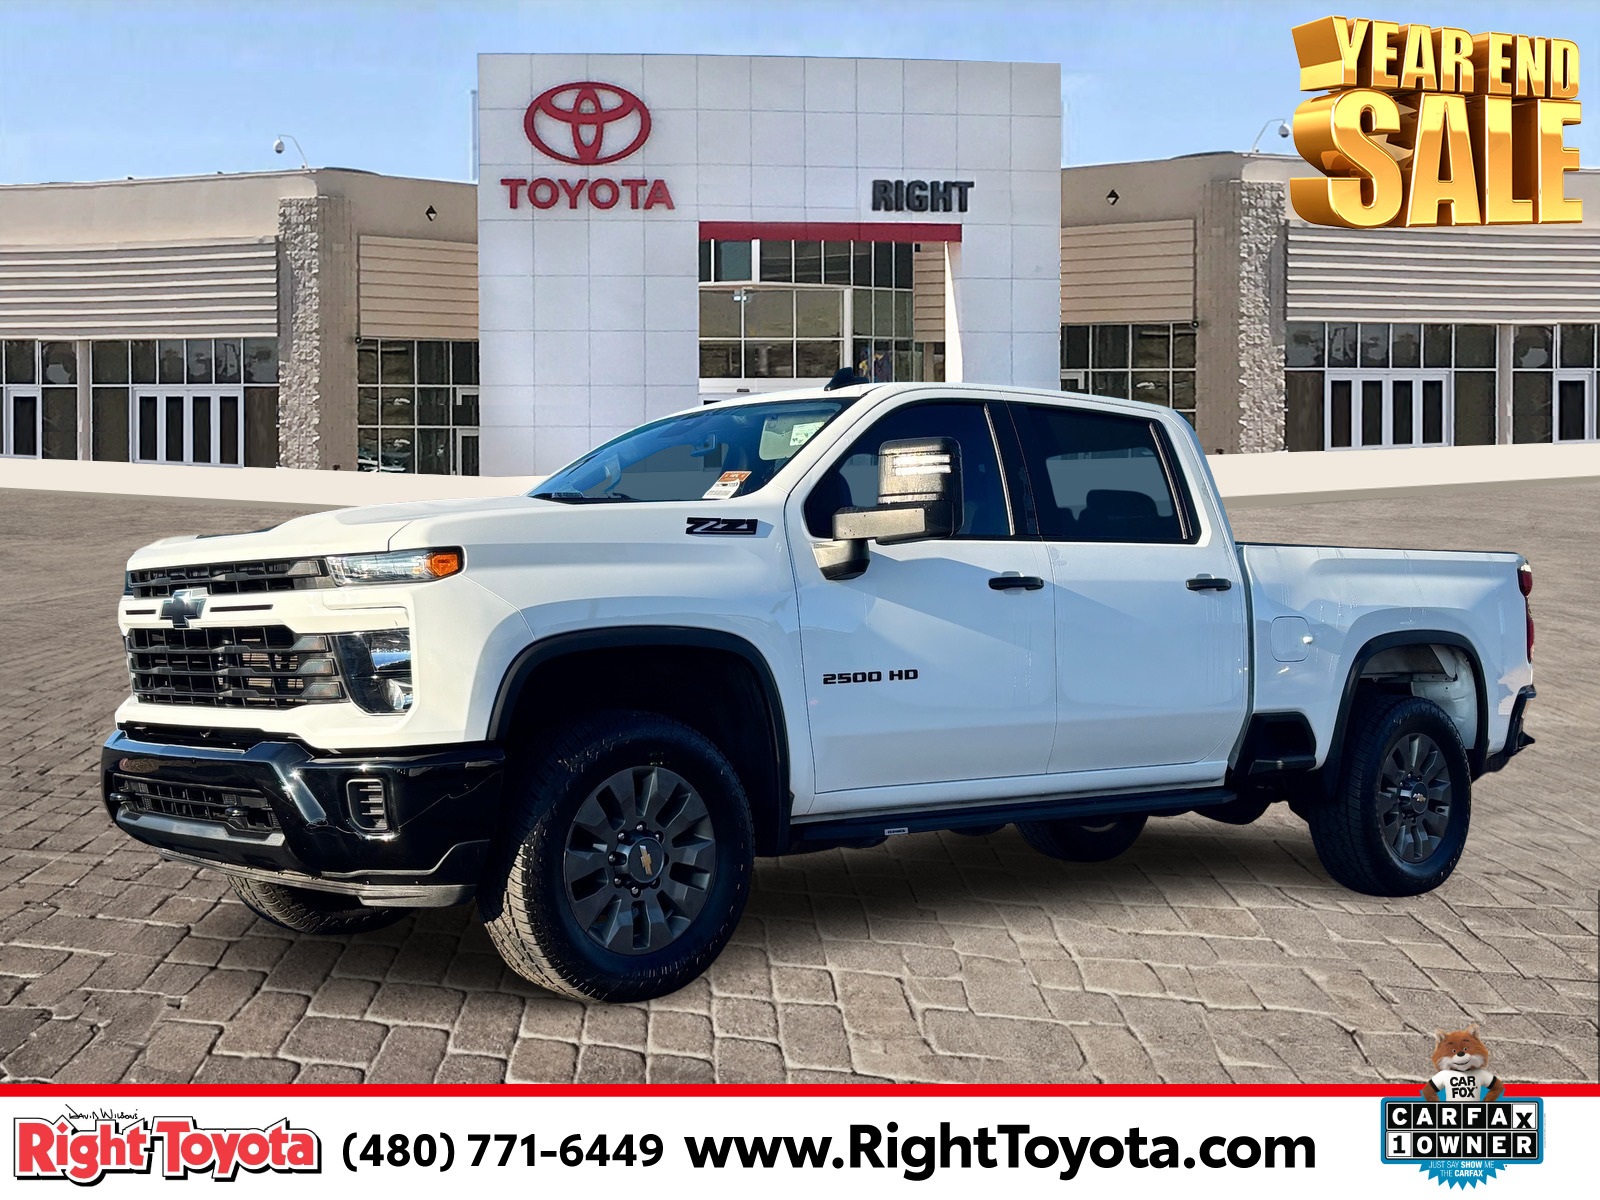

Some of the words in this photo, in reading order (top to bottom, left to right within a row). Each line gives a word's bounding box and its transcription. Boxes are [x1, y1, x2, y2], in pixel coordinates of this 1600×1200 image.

[500, 178, 675, 210] TOYOTA
[871, 179, 975, 213] RIGHT
[822, 671, 882, 685] 2500
[889, 669, 919, 682] HD
